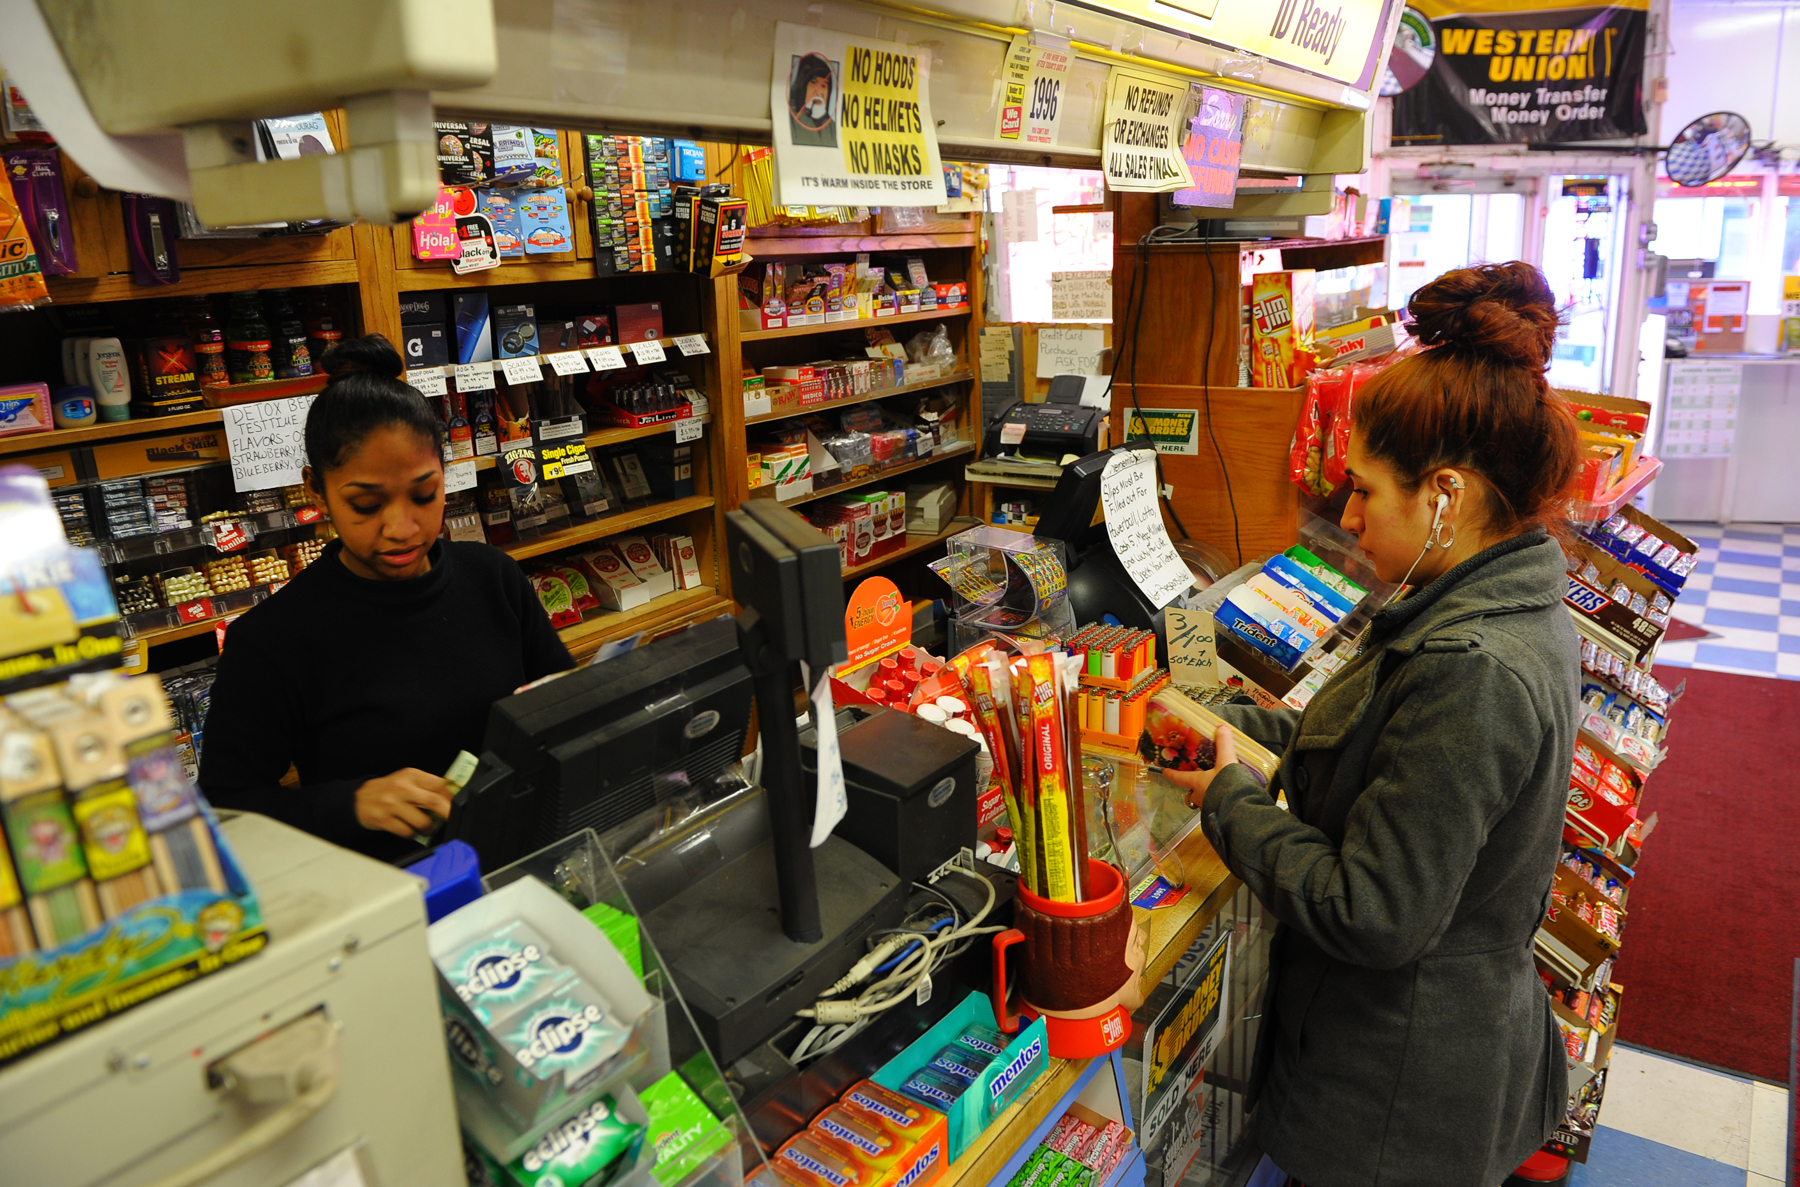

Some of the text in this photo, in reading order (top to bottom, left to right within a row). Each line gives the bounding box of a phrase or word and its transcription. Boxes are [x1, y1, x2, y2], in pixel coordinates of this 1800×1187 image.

[1270, 0, 1347, 65] ID Ready
[1441, 28, 1595, 55] WESTERN
[852, 47, 916, 91] NO HOODS
[1489, 55, 1588, 82] UNION
[1029, 76, 1060, 121] 1996
[1124, 84, 1174, 118] NO REFUNDS
[1469, 86, 1608, 109] Money Transfer
[840, 93, 922, 134] NO HELMETS
[1006, 108, 1019, 119] We
[1202, 94, 1238, 139] Sorry
[1491, 103, 1606, 126] Money Order
[1002, 118, 1020, 130] Card
[1114, 118, 1169, 150] OR EXCHANGES
[682, 148, 704, 158] TROJAN
[849, 140, 922, 175] NO MASKS
[1183, 133, 1242, 168] NO CASH
[1109, 152, 1180, 180] ALL SALES FINAL
[801, 176, 933, 191] IT'S WARM INSIDE THE STORE
[675, 212, 690, 220] FILTERS
[731, 219, 736, 230] 5
[1097, 219, 1111, 229] NO
[1052, 271, 1064, 281] NO
[1053, 284, 1067, 292] ANY
[1081, 291, 1104, 299] Marked
[1053, 309, 1104, 318] TIME AND DATE
[1253, 296, 1288, 320] slim
[1040, 329, 1083, 341] Credit Card
[96, 351, 121, 360] Jergens
[1040, 342, 1078, 356] Purchases
[506, 359, 532, 370] Scales
[1055, 356, 1098, 369] ASK FOR
[155, 372, 195, 386] STREAM
[778, 388, 797, 405] RAW
[802, 392, 823, 400] MEDICO
[230, 401, 282, 425] DETOX
[612, 416, 631, 425] Torch
[639, 410, 678, 425] JetLine
[1154, 417, 1191, 428] MONEY
[1149, 426, 1189, 436] ORDERS
[145, 440, 219, 456] Black Mild
[232, 433, 284, 453] FLAVORS
[541, 444, 587, 460] Single Cigar
[231, 445, 297, 467] STRAWBERRY
[574, 453, 590, 462] Pouch
[1103, 471, 1144, 503] Slips Must Be
[1108, 487, 1148, 517] Filled out For
[1136, 505, 1157, 523] Lotto,
[217, 536, 246, 553] Vanilla
[1114, 540, 1131, 555] Cash
[1123, 557, 1136, 569] and
[1131, 567, 1155, 584] Check
[1149, 561, 1162, 572] Your
[1147, 588, 1162, 602] Not
[853, 614, 875, 630] ENERGY
[856, 605, 875, 620] 5-hour
[1232, 618, 1278, 648] Trident
[1632, 617, 1650, 633] 48
[854, 638, 897, 661] No Sugar Crash
[1252, 687, 1276, 706] Trident
[1044, 723, 1054, 770] ORIGINAL
[981, 792, 1001, 813] Sugar
[980, 814, 985, 824] 4
[455, 943, 541, 1003] eclipse
[1183, 957, 1224, 1024] MONEY
[1103, 1016, 1121, 1035] slim
[1175, 982, 1220, 1053] ORDERS
[515, 1003, 603, 1069] eclipse
[960, 1034, 1004, 1055] entos
[935, 1057, 981, 1080] entos
[989, 1036, 1041, 1100] mentos
[1149, 1082, 1180, 1139] SOLD
[1183, 1036, 1213, 1089] HERE
[848, 1091, 914, 1128] mentos
[521, 1099, 611, 1172] eclipse
[817, 1117, 885, 1158] mentos
[782, 1147, 850, 1187] mentos
